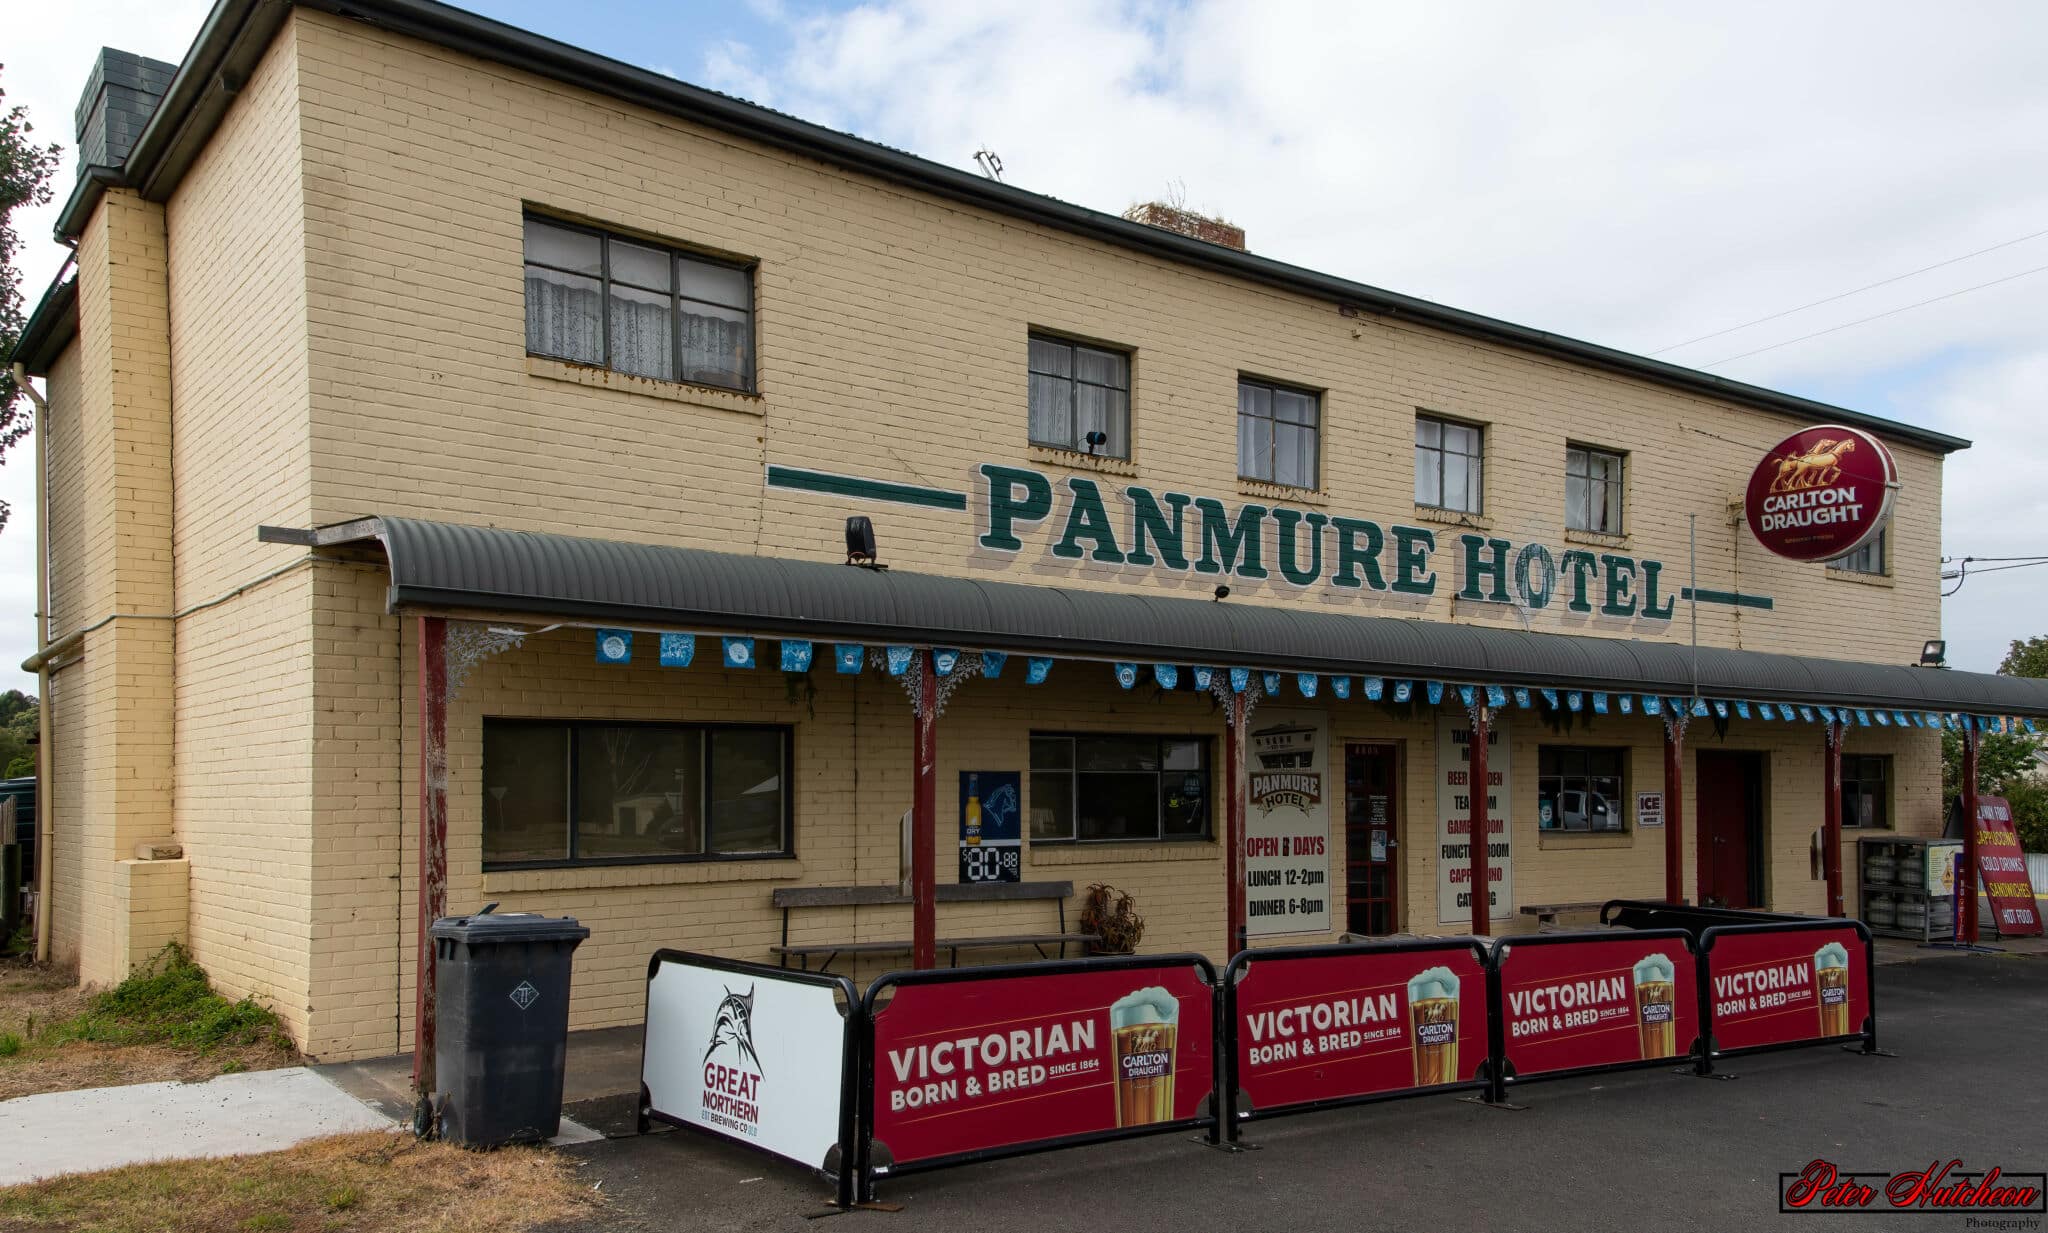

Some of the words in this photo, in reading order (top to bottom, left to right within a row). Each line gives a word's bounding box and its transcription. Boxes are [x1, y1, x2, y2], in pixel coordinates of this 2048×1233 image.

[1763, 486, 1856, 513] CARLTON
[1760, 504, 1863, 532] DRAUGHT
[979, 462, 1438, 596] PANMURE
[1460, 533, 1675, 621] HOTEL
[1448, 771, 1467, 785] BEER
[1253, 775, 1318, 800] PANMURE
[1265, 793, 1304, 808] HOTEL
[1454, 795, 1469, 809] TEA
[1640, 798, 1659, 810] ICE
[1994, 806, 2009, 821] FOOD
[1247, 837, 1278, 857] OPEN
[1293, 836, 1324, 856] DAYS
[1441, 844, 1472, 859] FUNCTI
[1981, 856, 2000, 871] COLD
[1999, 856, 2024, 872] DRINKS
[1248, 870, 1281, 887] LUNCH
[1285, 868, 1324, 886] 12-2pm
[1449, 866, 1502, 883] CAPPINO
[1989, 882, 2032, 898] SANDWICHES
[1249, 899, 1285, 916] DINNER
[1289, 898, 1323, 914] 6-8pm
[2001, 908, 2017, 924] HOT
[2016, 909, 2034, 925] FOOD
[1714, 963, 1809, 998] VICTORIAN
[1508, 976, 1626, 1016] VICTORIAN
[1821, 988, 1845, 998] CARLTON
[1642, 1004, 1670, 1015] CARLTON
[1716, 999, 1746, 1017] BORN
[1749, 996, 1758, 1011] &
[1759, 991, 1786, 1009] BRED
[1247, 992, 1398, 1042] VICTORIAN
[1511, 1019, 1548, 1037] BORN
[1552, 1014, 1562, 1030] &
[1565, 1009, 1598, 1027] BRED
[1600, 1009, 1616, 1017] SINCE
[1418, 1023, 1453, 1036] CARLTON
[1422, 1033, 1450, 1043] DRAUGHT
[887, 1019, 1095, 1083] VICTORIAN
[1249, 1040, 1297, 1066] BORN
[1302, 1038, 1315, 1055] &
[1319, 1030, 1361, 1052] BRED
[1363, 1029, 1384, 1040] SINCE
[1386, 1027, 1400, 1036] 1864
[1122, 1053, 1168, 1068] CARLTON
[1128, 1065, 1163, 1077] DRAUGHT
[704, 1062, 760, 1102] GREAT
[891, 1079, 957, 1112] BORN
[965, 1076, 983, 1097] &
[988, 1064, 1046, 1092] BRED
[1049, 1061, 1077, 1076] SINCE
[1079, 1058, 1100, 1071] 1864
[702, 1090, 759, 1124] NORTHERN
[710, 1113, 739, 1130] BREWING
